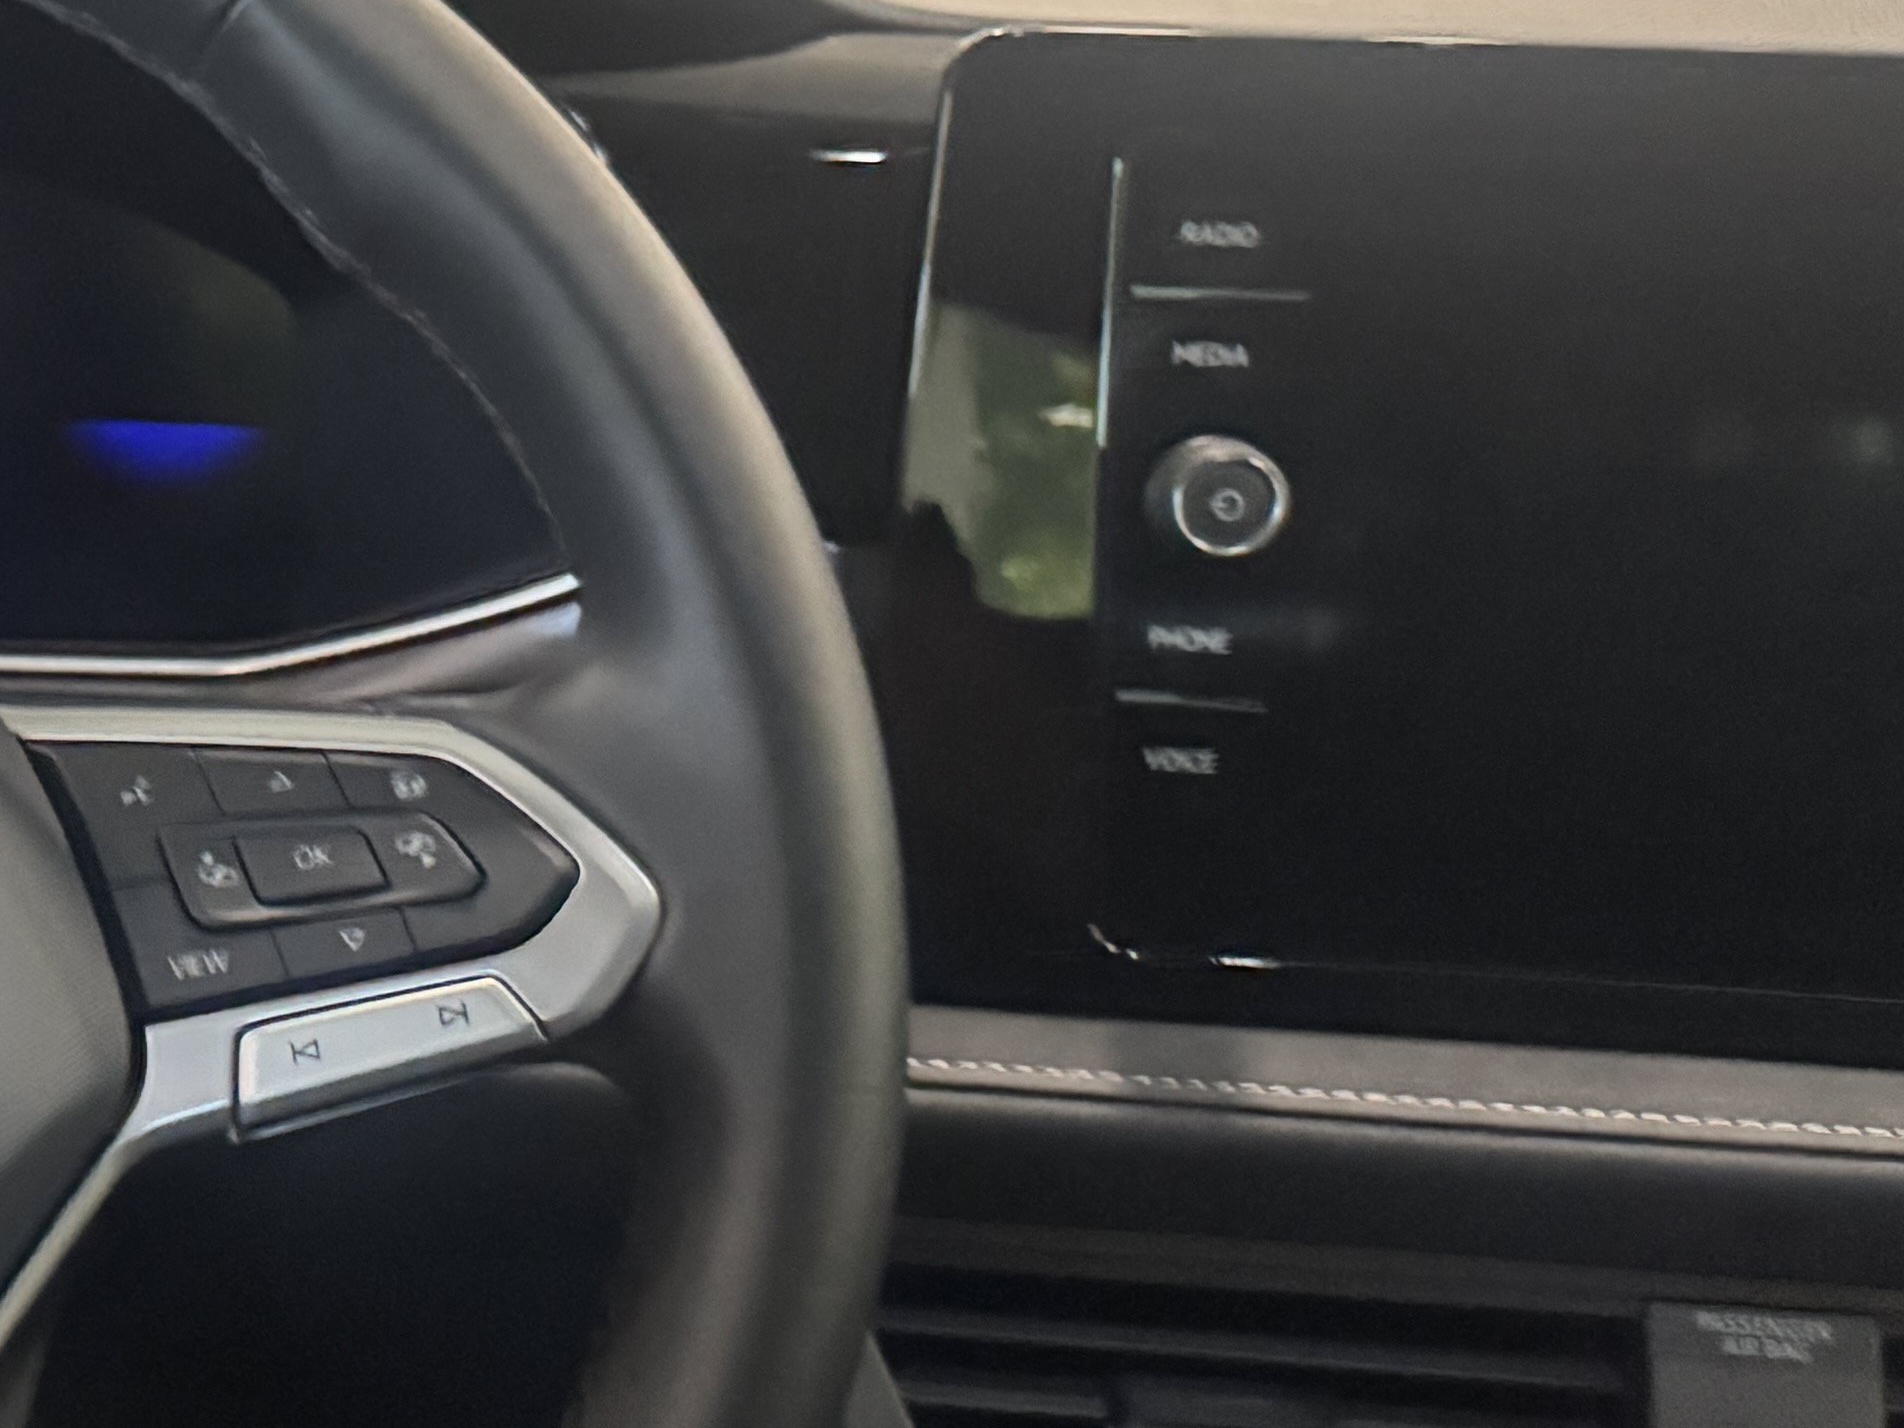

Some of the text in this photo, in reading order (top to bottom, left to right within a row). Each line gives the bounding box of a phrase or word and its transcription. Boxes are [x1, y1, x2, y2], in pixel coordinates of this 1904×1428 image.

[1179, 220, 1260, 249] RADIO
[1171, 340, 1250, 368] MEDIA
[1147, 624, 1233, 655] PHONE
[291, 843, 334, 871] OK
